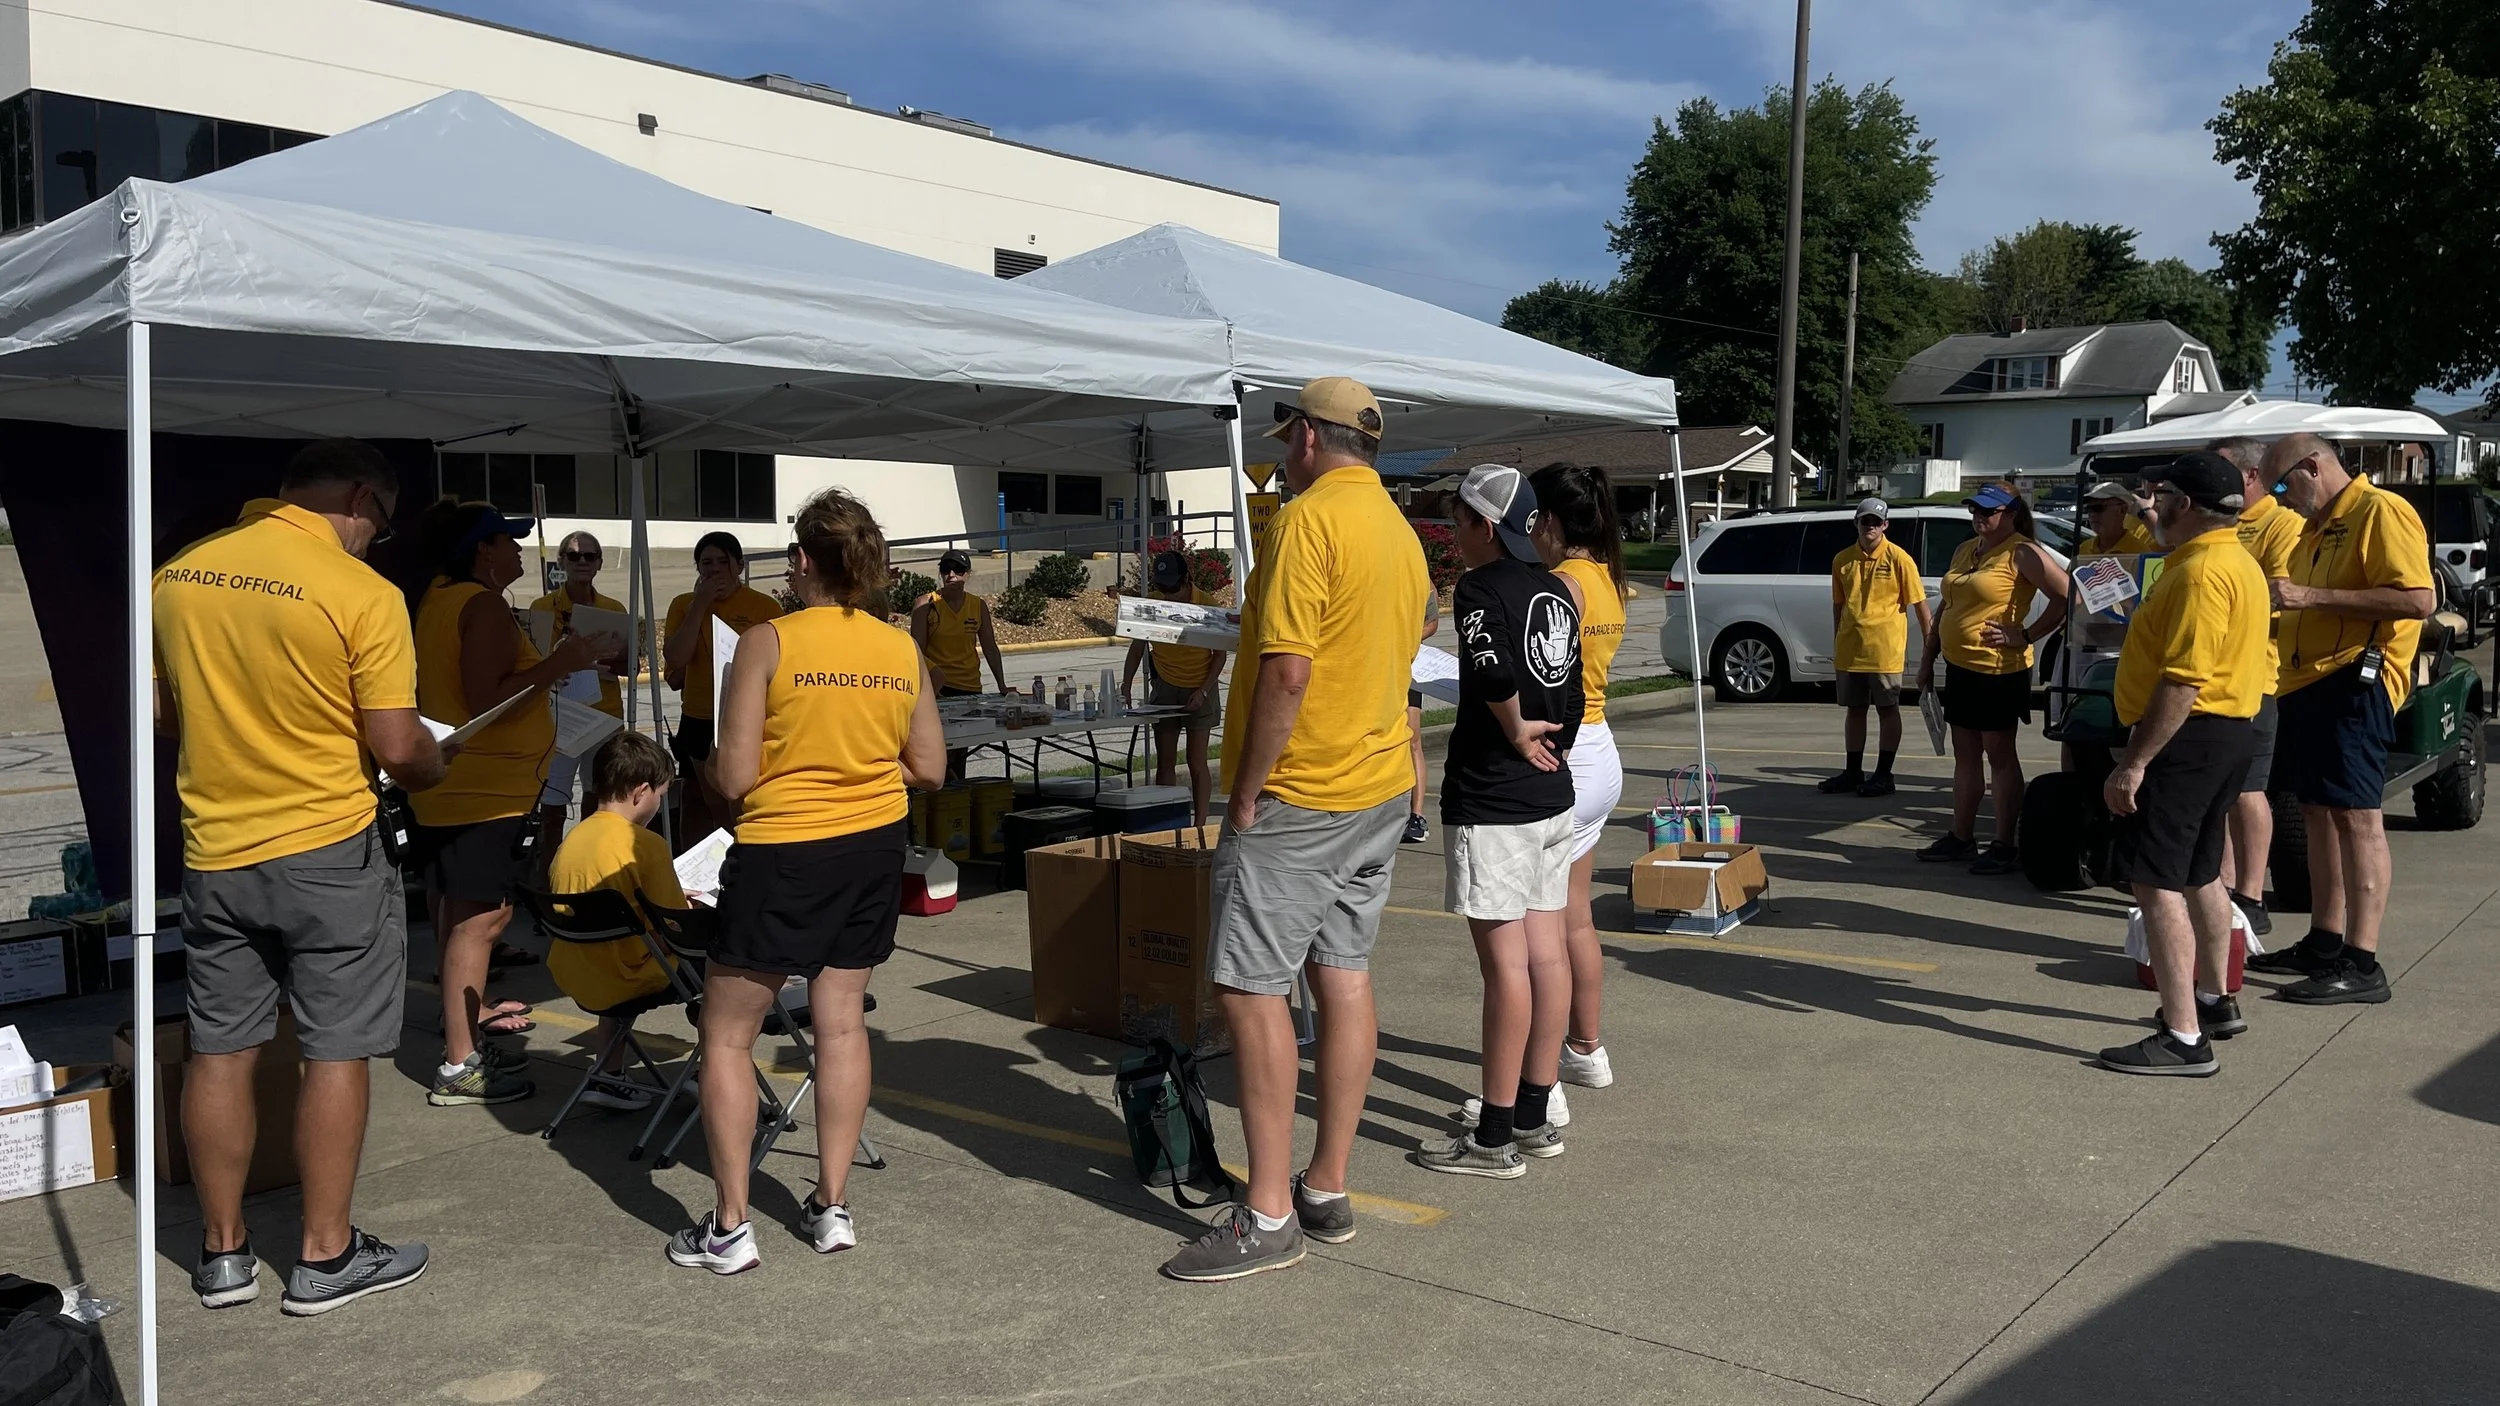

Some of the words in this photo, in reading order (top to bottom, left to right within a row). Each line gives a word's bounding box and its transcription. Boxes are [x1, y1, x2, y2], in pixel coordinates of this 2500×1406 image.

[1252, 505, 1270, 517] TWO
[164, 568, 227, 587] PARADE
[229, 575, 305, 601] OFFICIAL
[1583, 623, 1610, 638] PARADE
[794, 671, 859, 688] PARADE
[861, 674, 914, 696] OFFICIAL
[1127, 935, 1137, 948] 12
[1144, 944, 1152, 958] 12
